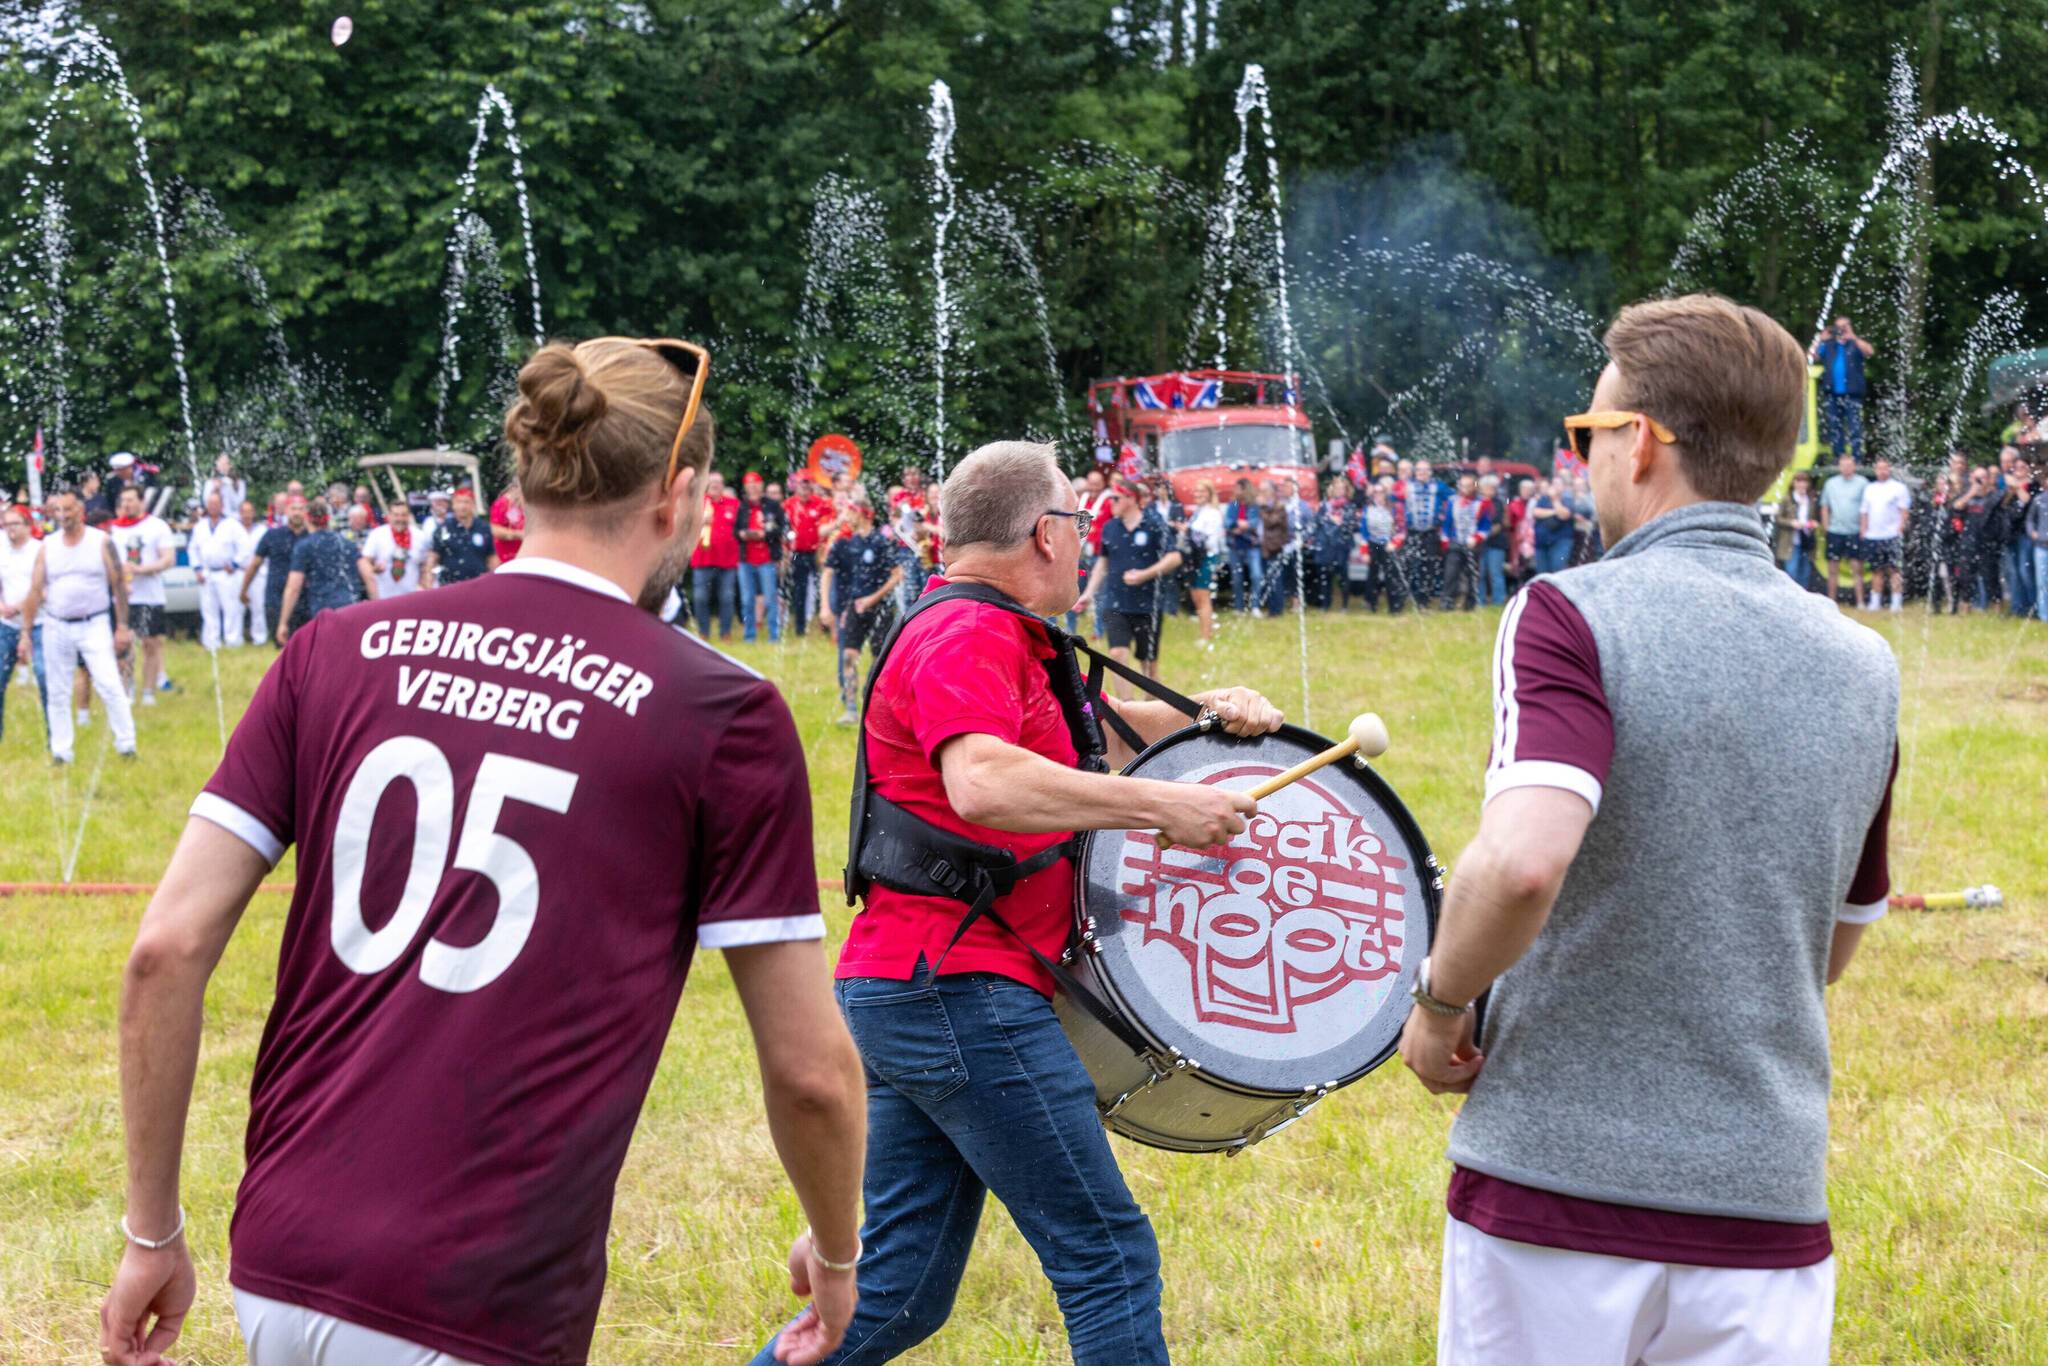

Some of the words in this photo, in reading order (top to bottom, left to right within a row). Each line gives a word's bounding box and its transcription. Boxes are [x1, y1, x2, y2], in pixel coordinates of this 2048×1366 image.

[360, 619, 654, 717] GEBIRGSJÄGER
[396, 666, 585, 740] VERBERG
[330, 735, 580, 994] 05
